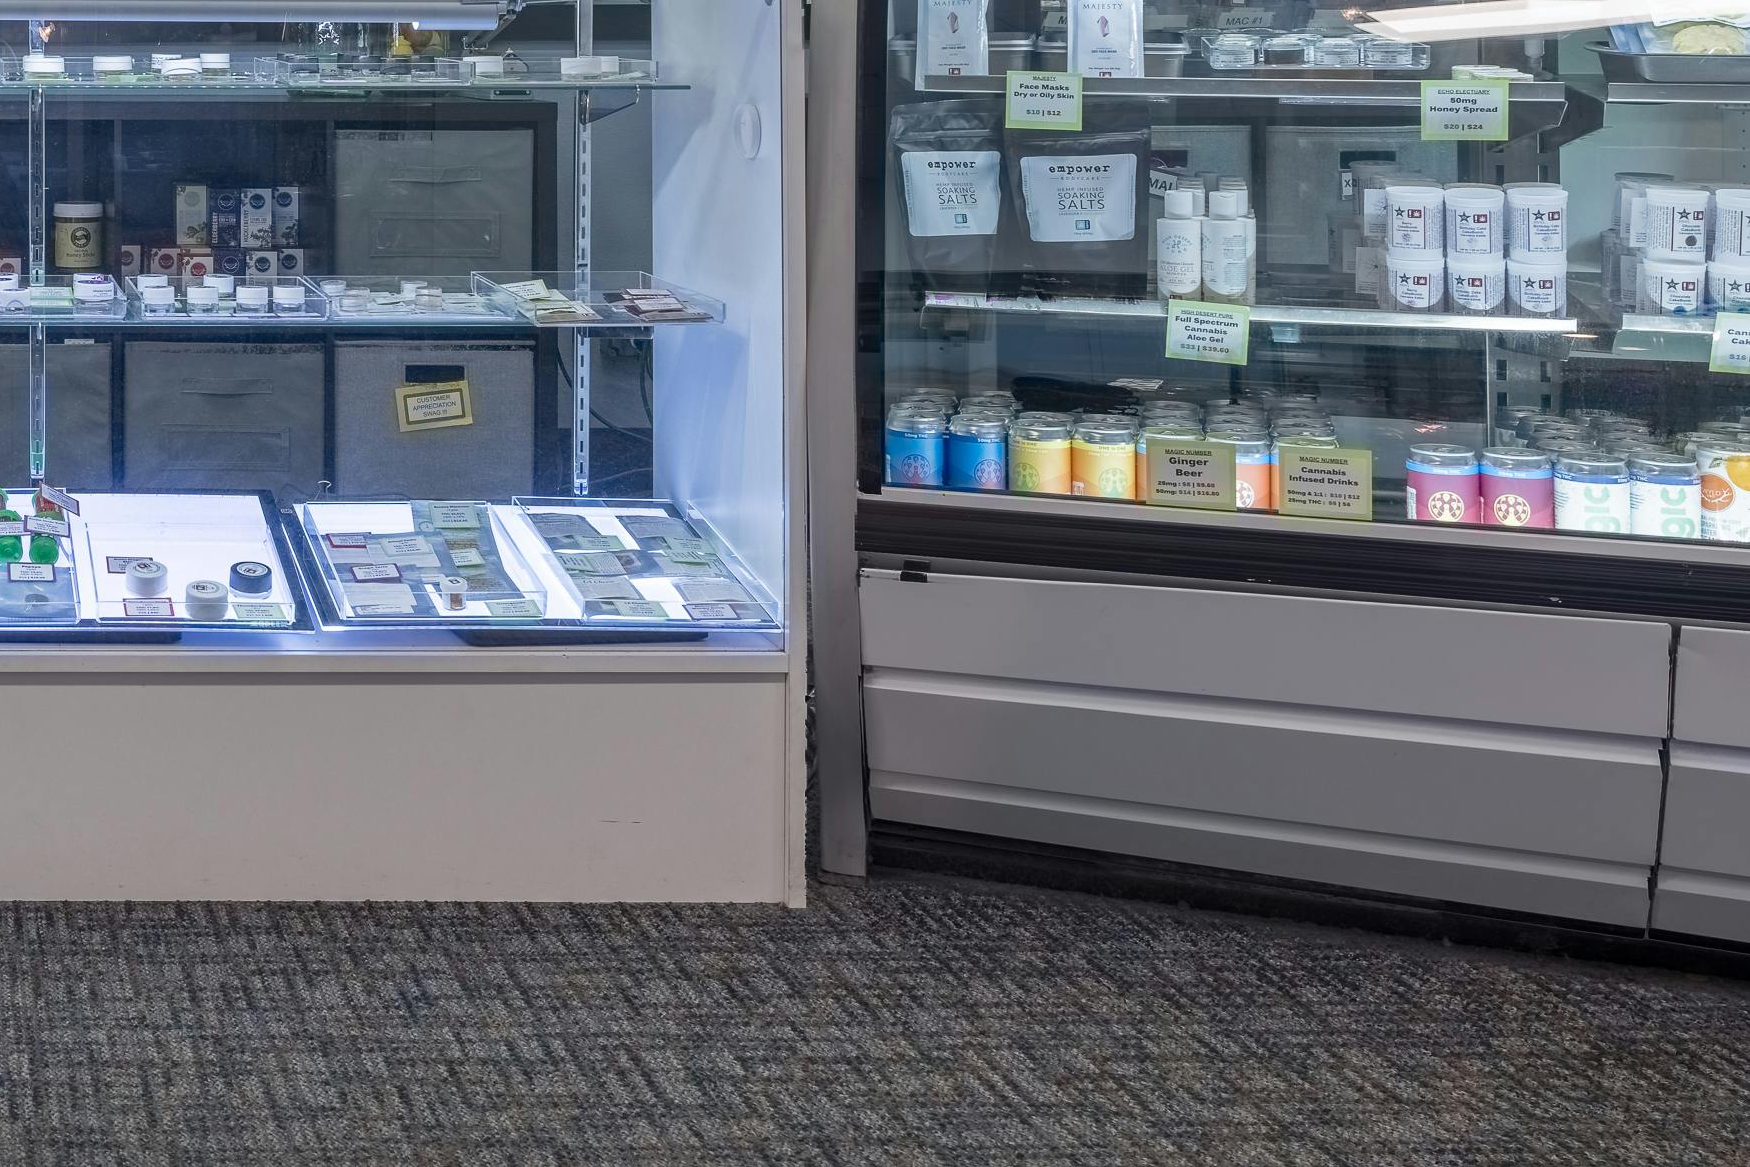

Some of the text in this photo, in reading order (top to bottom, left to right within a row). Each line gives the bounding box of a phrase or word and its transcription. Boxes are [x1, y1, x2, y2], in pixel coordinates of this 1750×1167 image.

[933, 0, 973, 7] MAJESTY
[1450, 97, 1477, 106] 50mg
[1429, 105, 1498, 115] Honey Spread
[928, 160, 976, 171] empower
[939, 194, 977, 205] SALTS
[1194, 317, 1239, 328] Spectrum
[1185, 326, 1228, 335] Cannabis
[1187, 334, 1224, 344] Aloe Gel
[417, 395, 450, 403] CUSTOMER
[413, 401, 456, 411] APPRECIATION
[1169, 457, 1209, 467] Ginger
[1176, 468, 1203, 477] Beer
